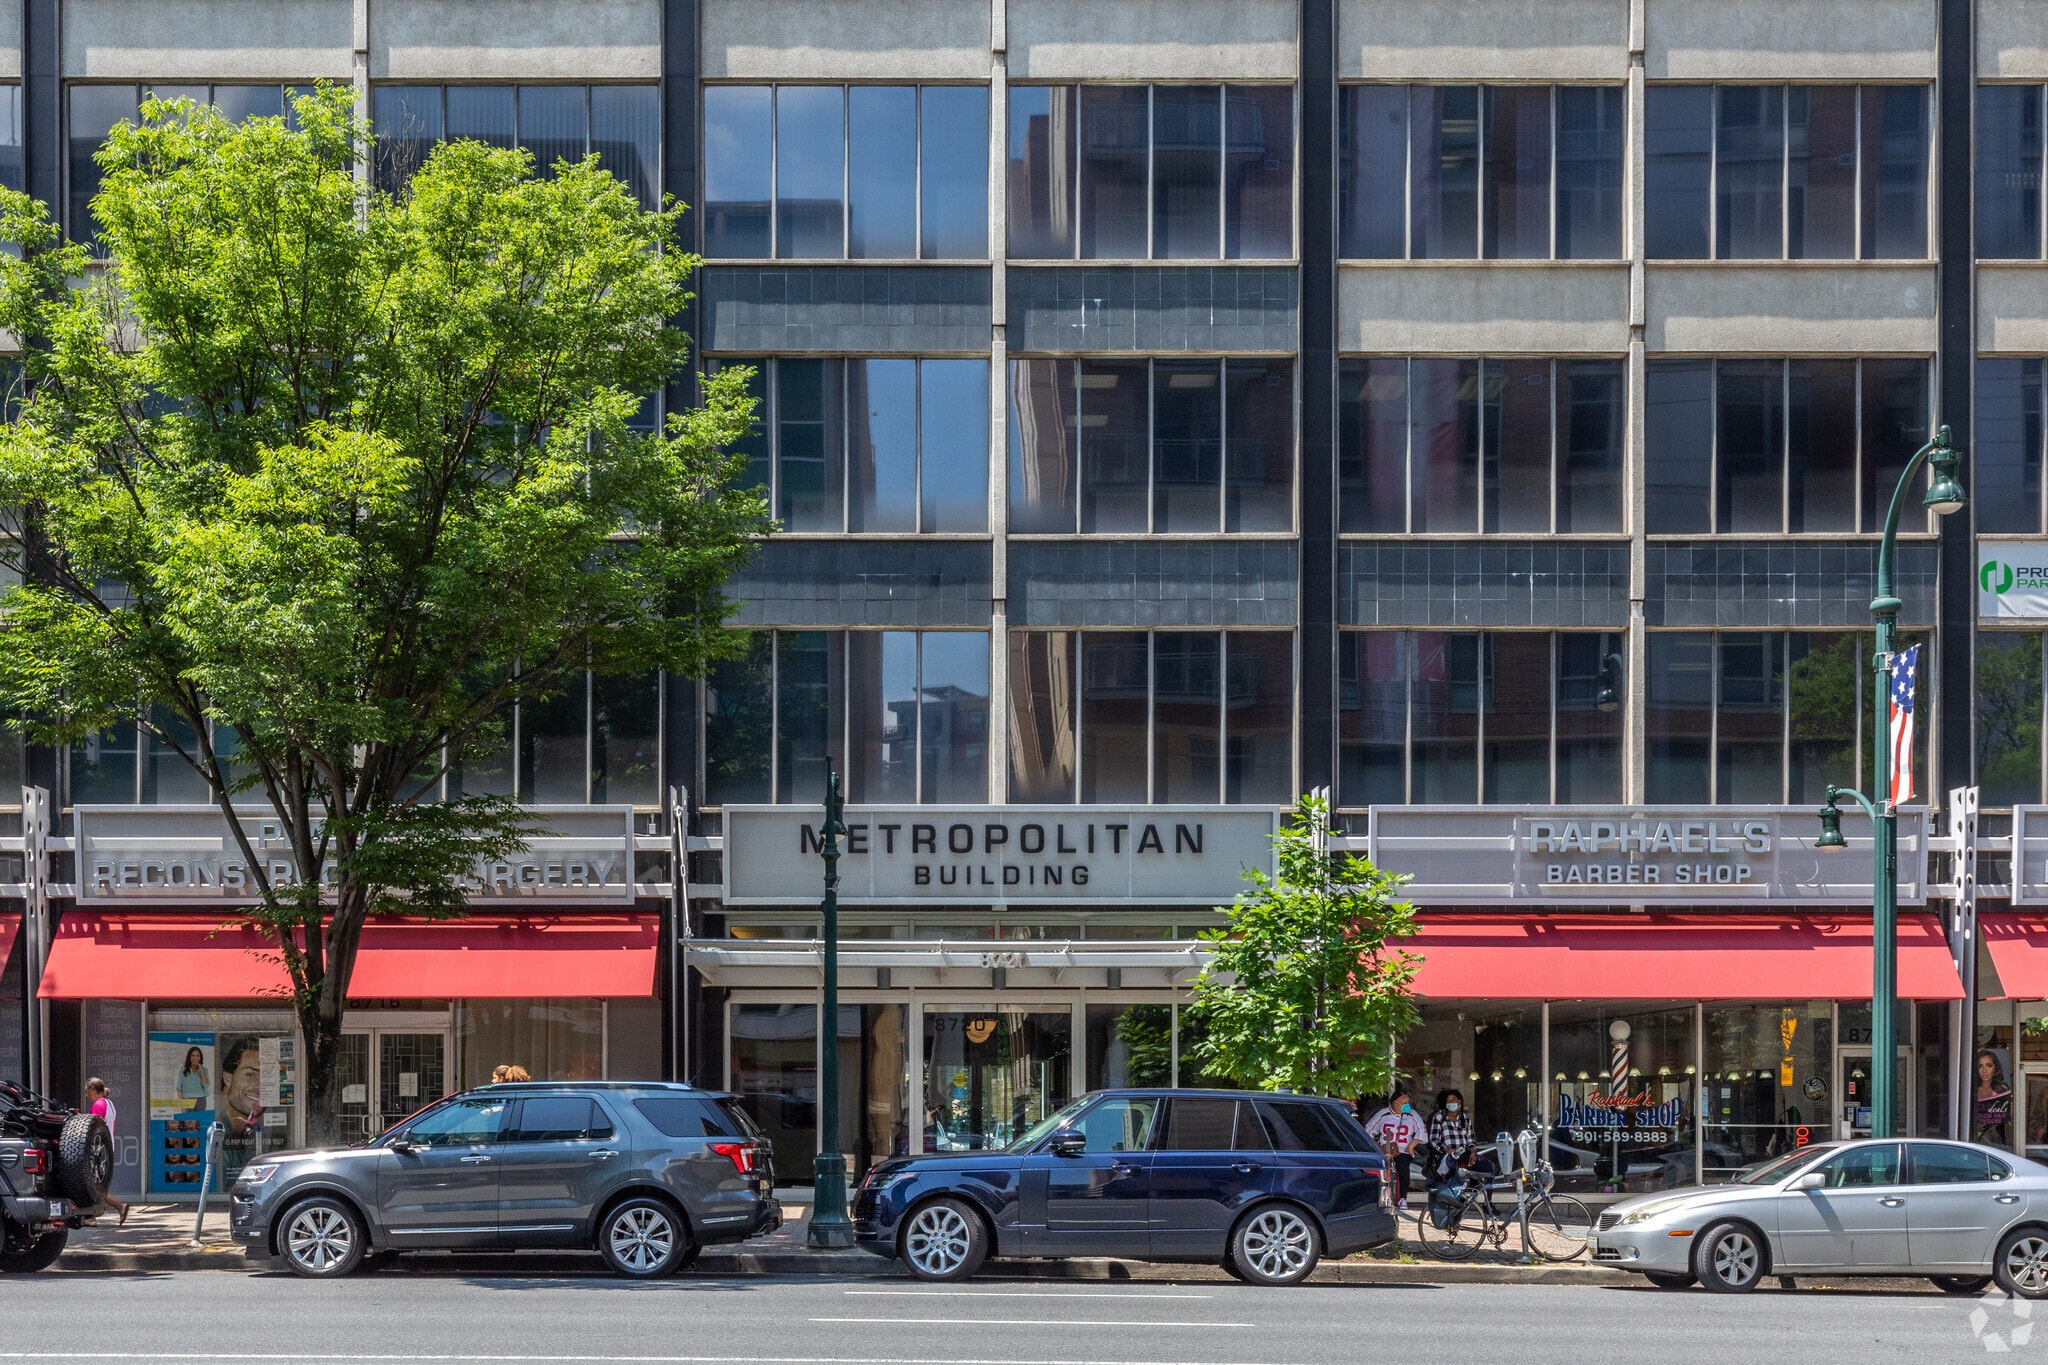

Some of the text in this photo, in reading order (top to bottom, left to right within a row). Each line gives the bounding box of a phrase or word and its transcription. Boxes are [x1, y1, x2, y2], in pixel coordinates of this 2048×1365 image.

[800, 824, 1203, 854] METROPOLITAN
[1530, 821, 1770, 853] RAPHAEL'S
[443, 859, 616, 889] URGERY
[914, 865, 1089, 886] BUILDING
[1546, 863, 1752, 884] BARBER SHOP
[980, 952, 1029, 969] 8720
[935, 1018, 985, 1031] 8720
[1558, 1093, 1685, 1128] BARBER SHOP
[1383, 1123, 1409, 1143] 52
